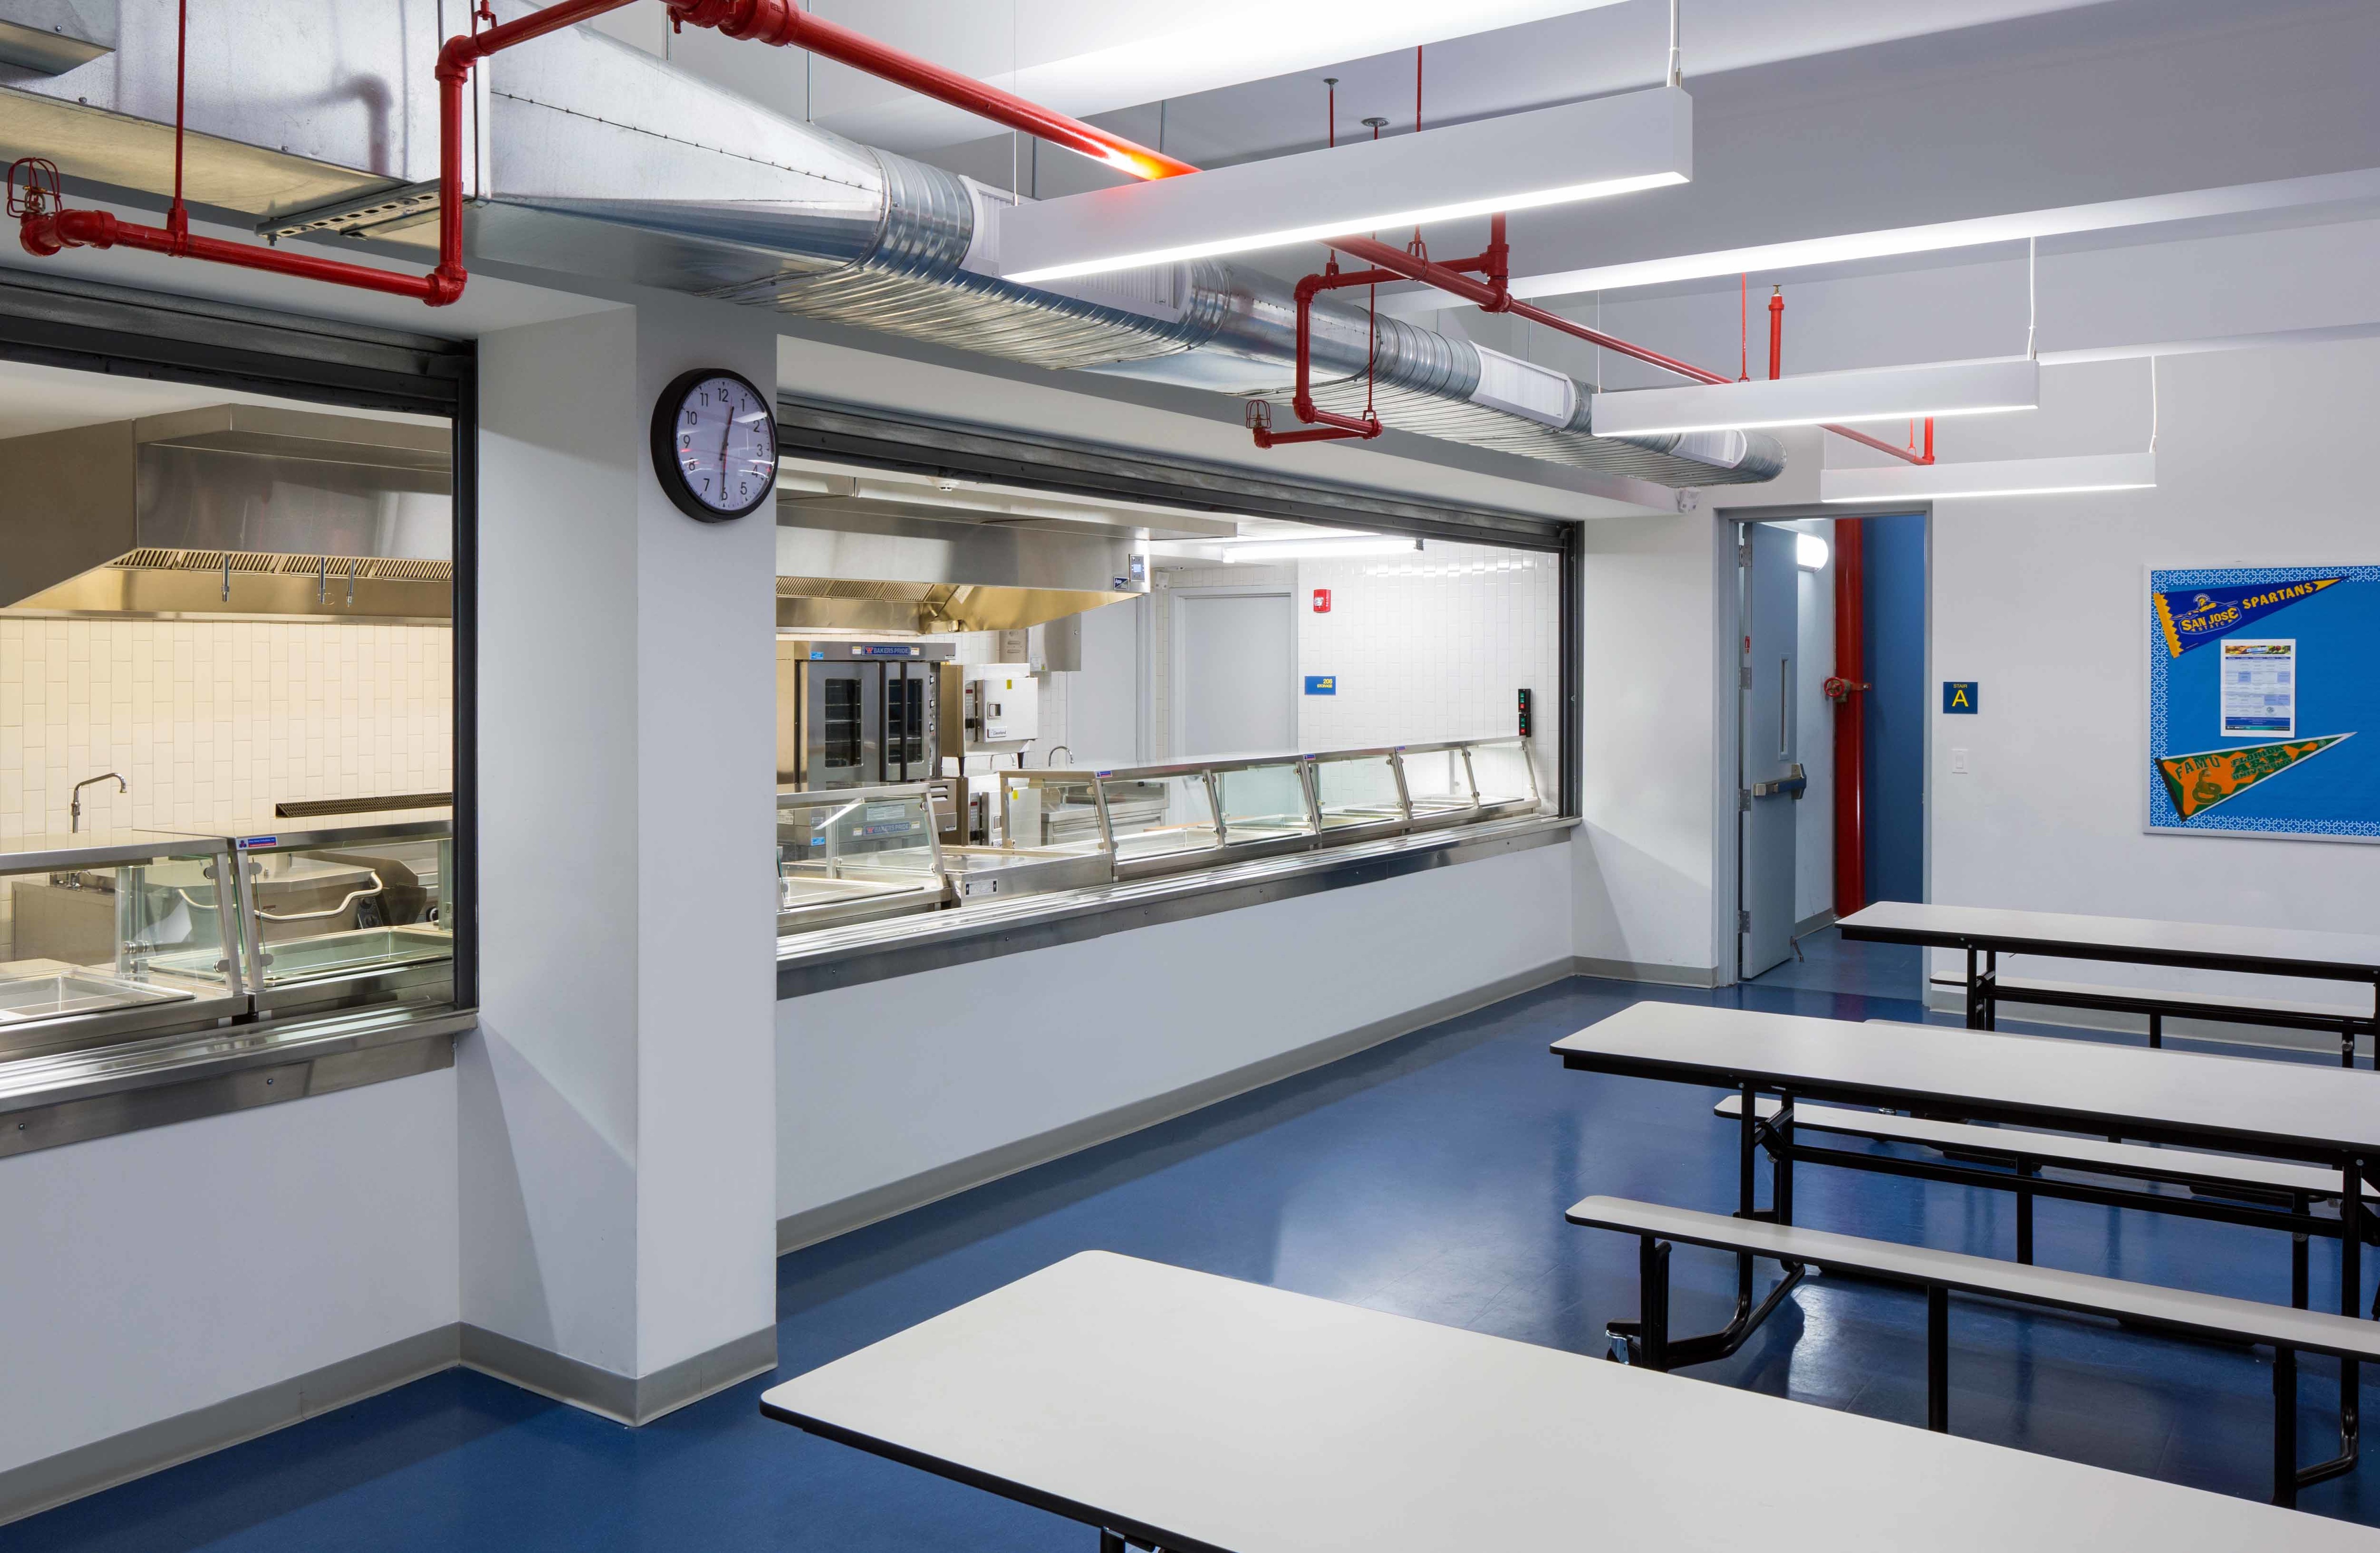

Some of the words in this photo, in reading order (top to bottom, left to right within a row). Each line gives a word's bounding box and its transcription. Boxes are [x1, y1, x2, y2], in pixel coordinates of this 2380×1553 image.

[700, 393, 709, 407] 11
[718, 388, 728, 402] 12
[741, 398, 744, 412] 1
[686, 411, 697, 425] 10
[753, 420, 760, 433] 2
[683, 435, 691, 448] 9
[756, 444, 763, 457] 3
[689, 457, 695, 471] 8
[752, 465, 758, 477] 4
[704, 478, 710, 492] 7
[740, 482, 748, 495] 5
[721, 487, 728, 501] 6
[2242, 583, 2314, 609] SPARTANS
[2181, 617, 2207, 631] SAN
[2209, 607, 2239, 624] JOSE
[1952, 689, 1969, 707] A
[2231, 745, 2285, 768] FLORIDA
[2233, 750, 2293, 775] A&M
[2175, 756, 2221, 780] FAMU
[2231, 758, 2293, 781] UNIVERSITY
